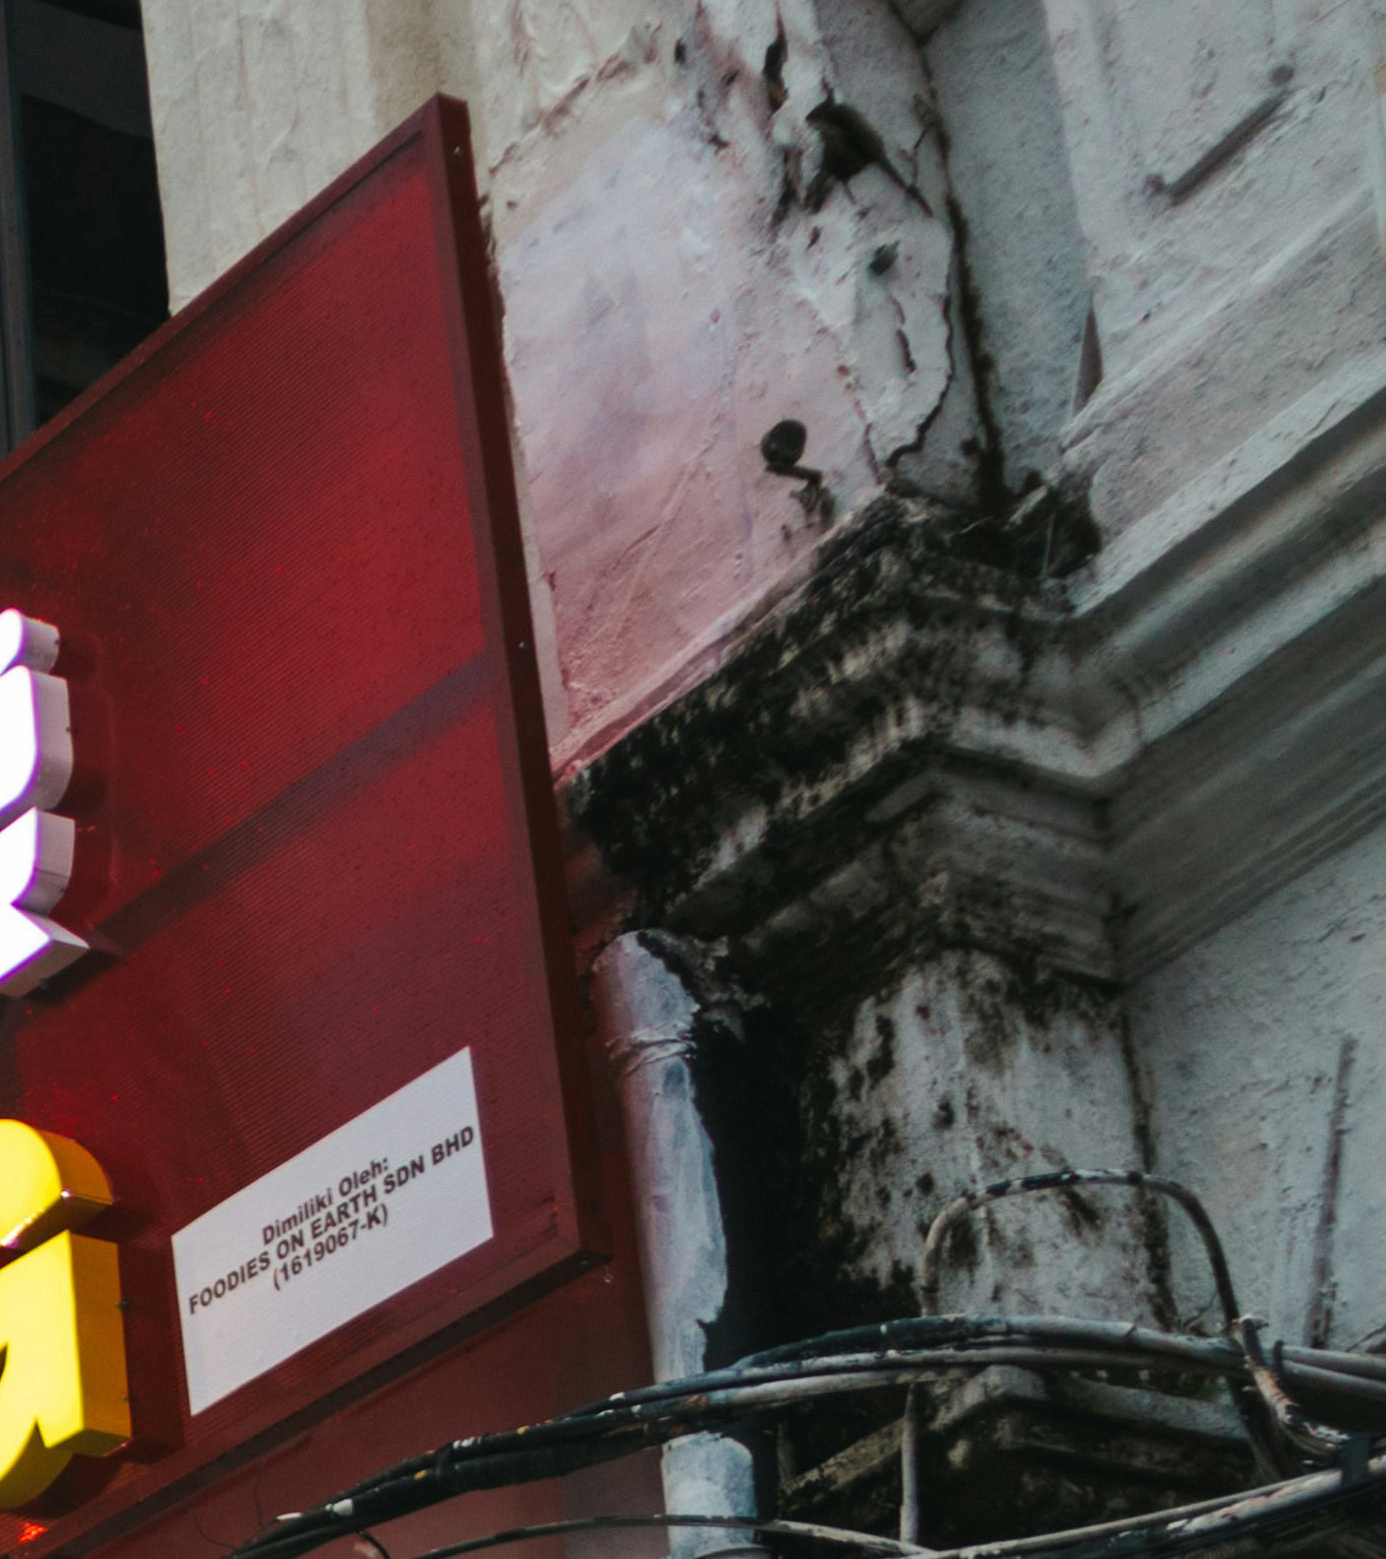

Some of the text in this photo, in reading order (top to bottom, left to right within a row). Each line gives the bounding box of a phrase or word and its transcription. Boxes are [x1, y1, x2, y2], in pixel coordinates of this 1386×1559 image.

[187, 1125, 475, 1316] FOODIES ON EARTH SDN BHD
[261, 1156, 389, 1246] Dimiliki Oleh:
[273, 1202, 388, 1292] (1619067-K)
